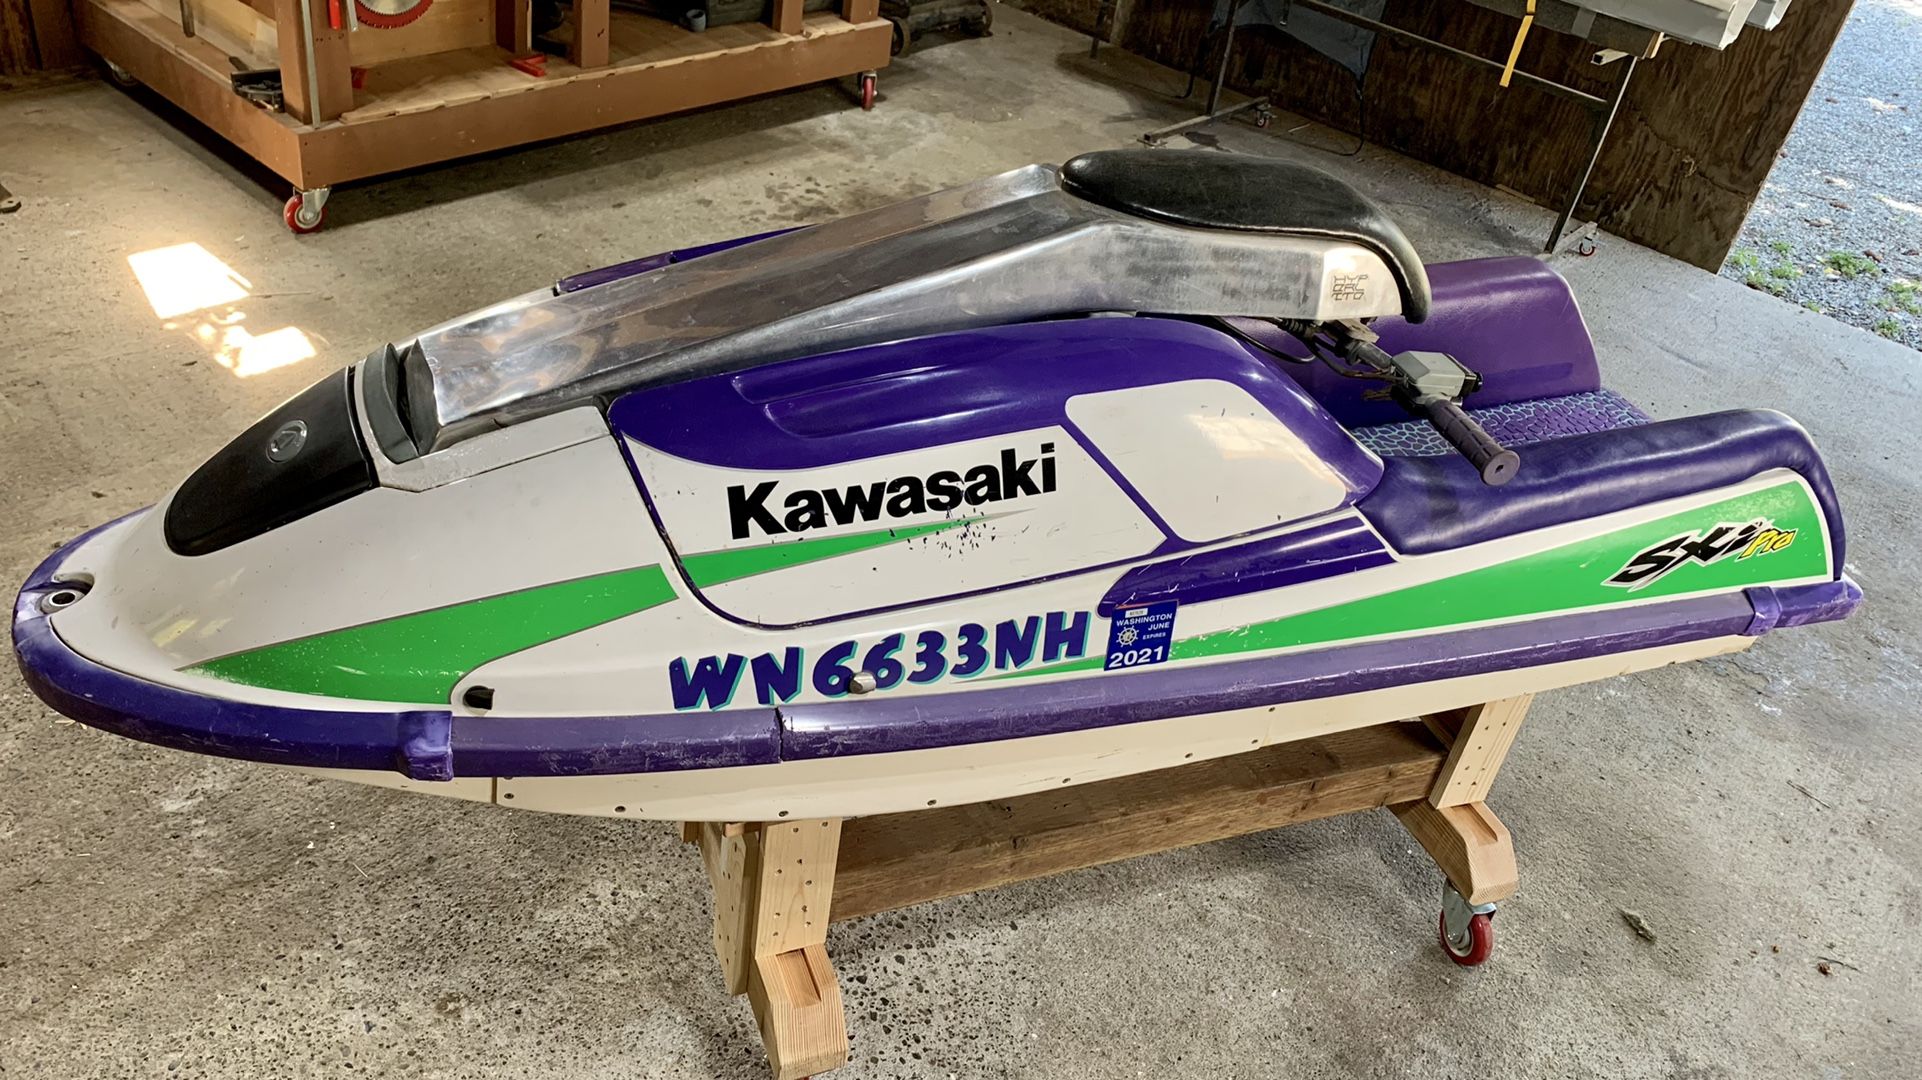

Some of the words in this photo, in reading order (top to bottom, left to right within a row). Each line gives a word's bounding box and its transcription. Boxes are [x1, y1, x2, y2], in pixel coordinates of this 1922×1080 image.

[727, 442, 1056, 540] Kawasaki
[1116, 612, 1173, 627] WASHINGTON
[1147, 621, 1170, 631] JUNE
[1142, 632, 1166, 640] EXPIRES
[1108, 645, 1163, 668] 2021
